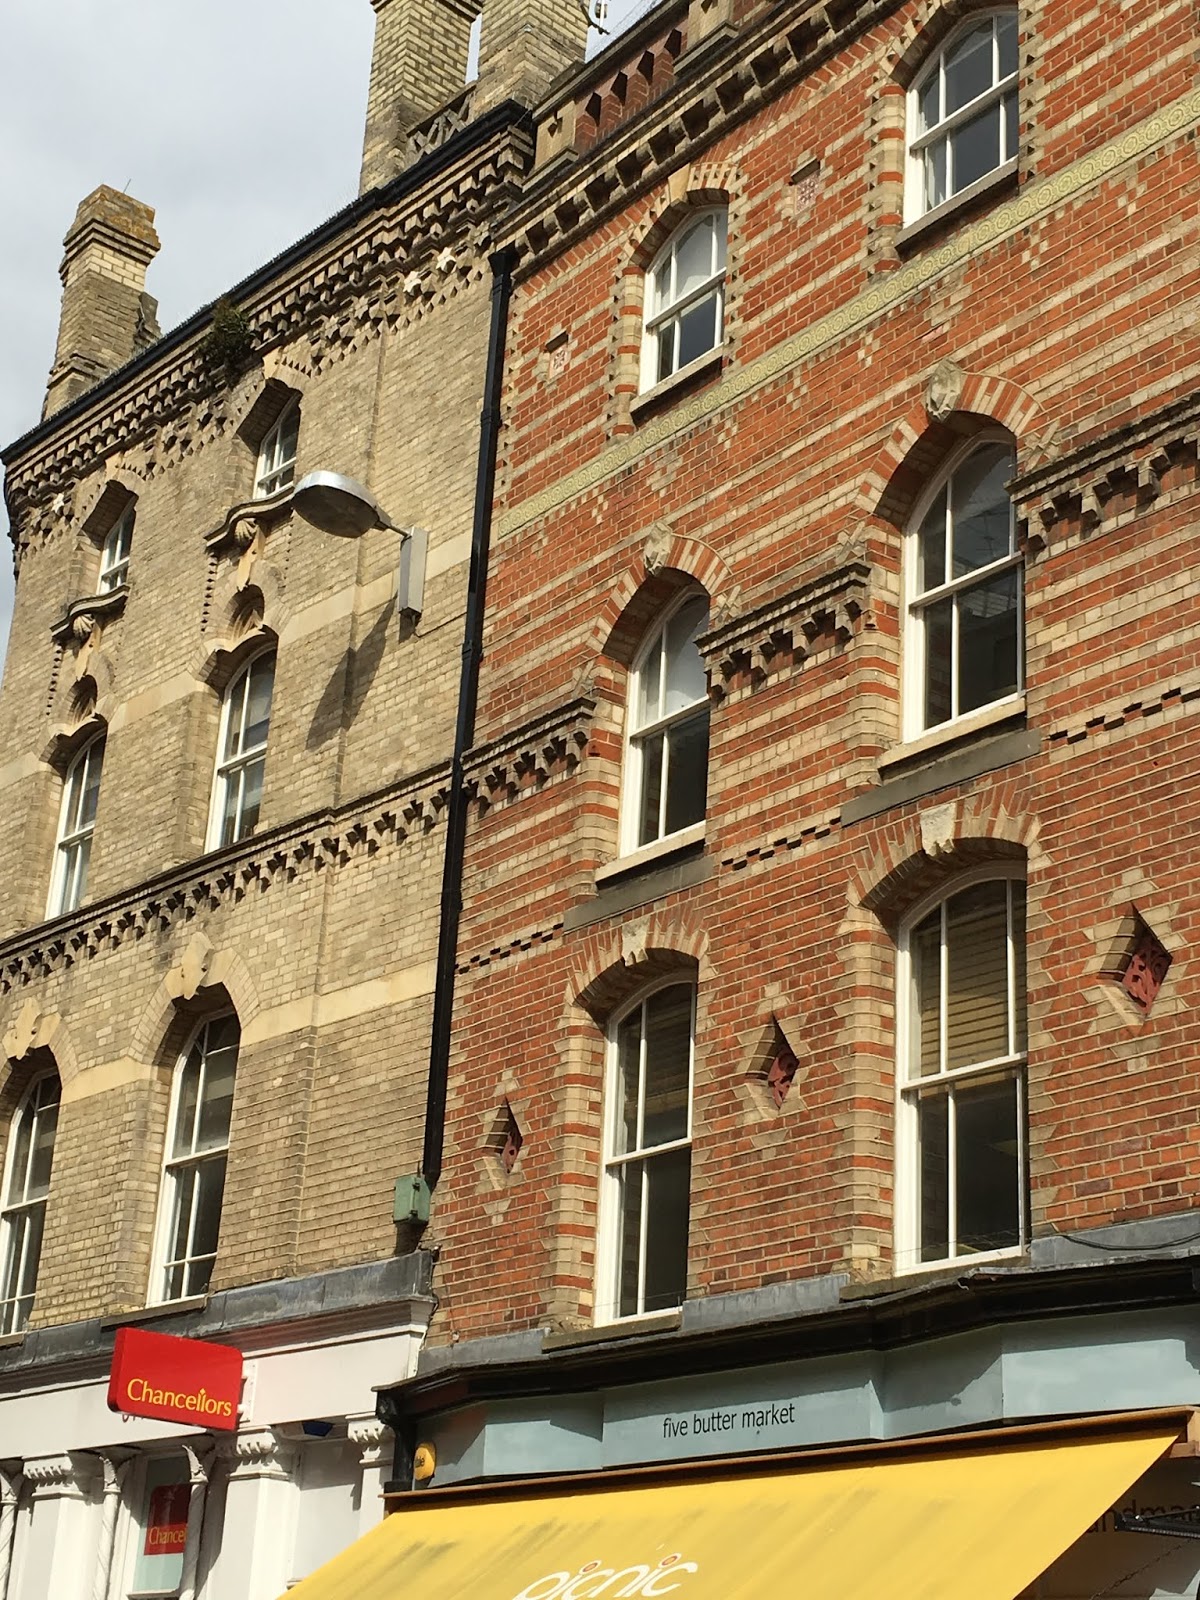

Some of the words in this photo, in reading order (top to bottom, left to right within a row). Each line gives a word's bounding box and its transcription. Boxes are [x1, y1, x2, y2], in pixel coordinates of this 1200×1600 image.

[127, 1378, 232, 1417] Chancellors
[663, 1417, 688, 1438] five
[693, 1412, 737, 1434] butter
[742, 1403, 795, 1428] market
